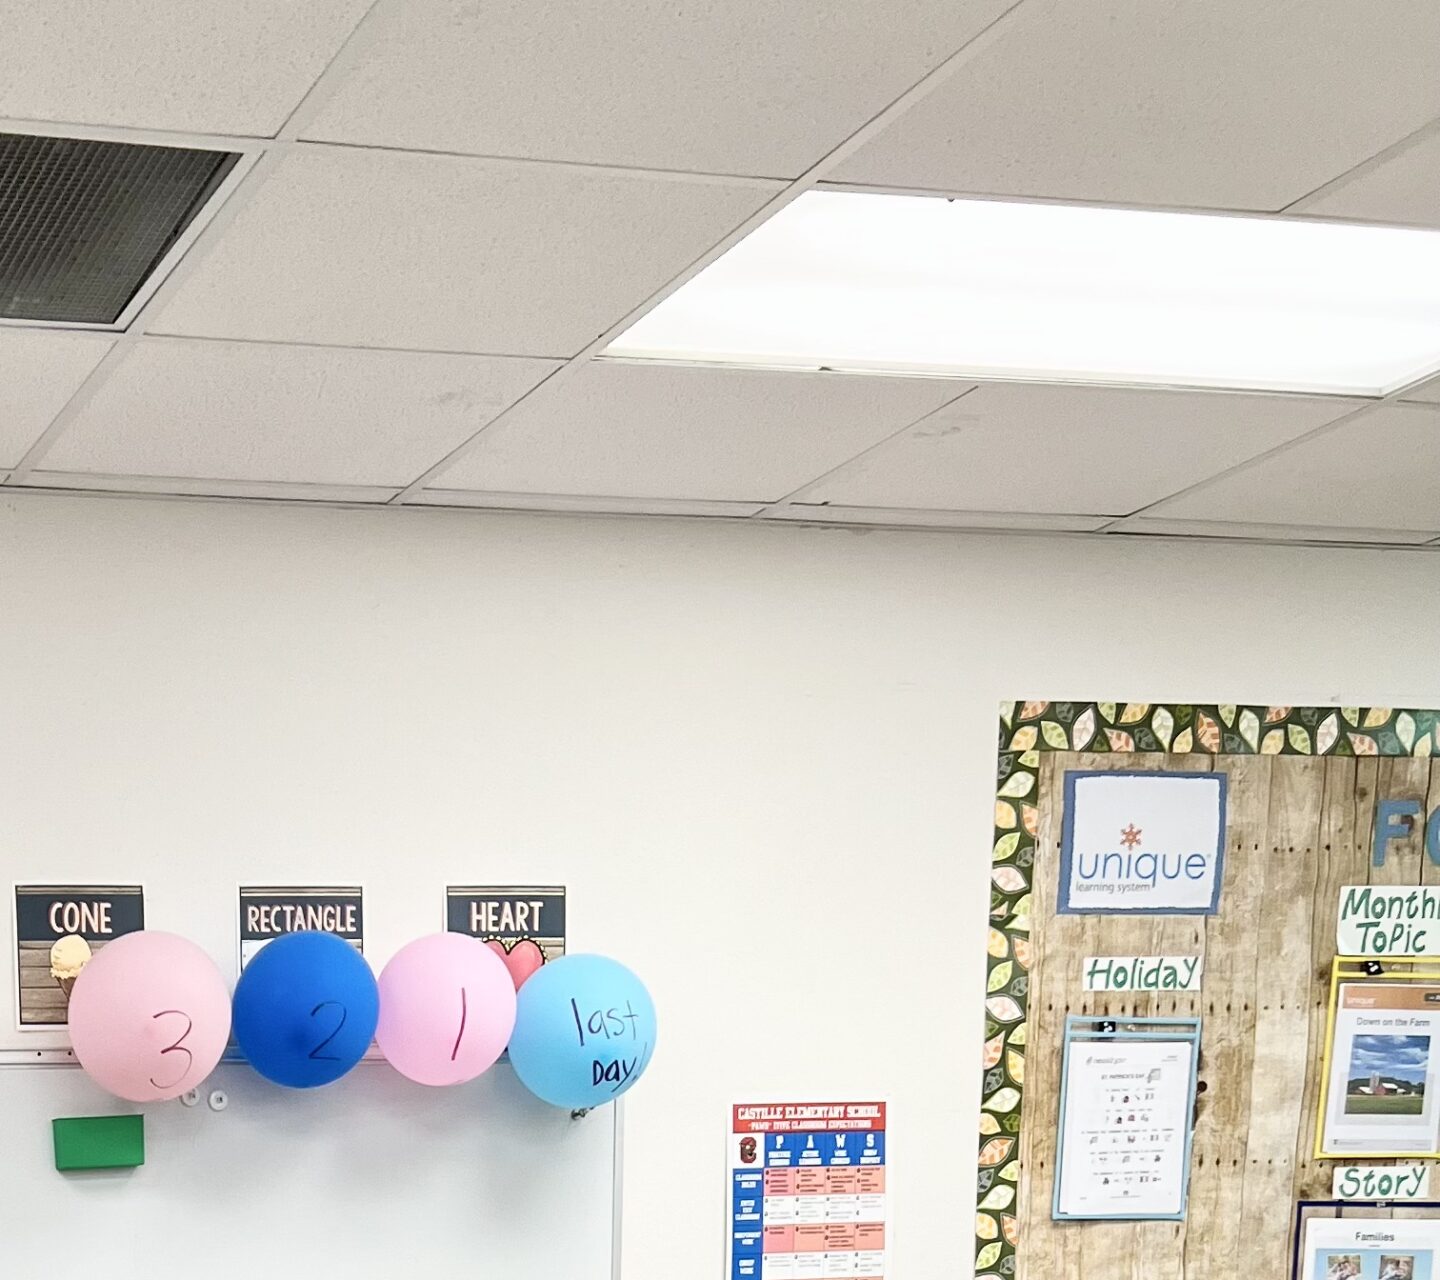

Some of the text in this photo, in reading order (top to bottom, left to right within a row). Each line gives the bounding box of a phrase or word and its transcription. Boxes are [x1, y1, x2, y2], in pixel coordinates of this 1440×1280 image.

[1372, 799, 1440, 868] F
[1078, 853, 1207, 888] unique
[1075, 881, 1151, 894] learning system
[49, 900, 113, 935] CONE
[247, 904, 357, 934] RECTANGLE
[469, 900, 545, 933] HEART
[308, 1001, 348, 1061] 2
[450, 987, 467, 1061] 1
[571, 998, 639, 1046] last
[1356, 1017, 1380, 1026] Down
[1395, 1018, 1407, 1026] the
[1409, 1018, 1430, 1026] Farm
[150, 1010, 193, 1089] 3
[738, 1105, 881, 1120] CASTILLE ELEMENTARY SCHOOL
[776, 1135, 784, 1149] P
[806, 1135, 814, 1148] A
[835, 1133, 847, 1148] W
[866, 1133, 875, 1147] S
[1355, 1231, 1395, 1242] Families
